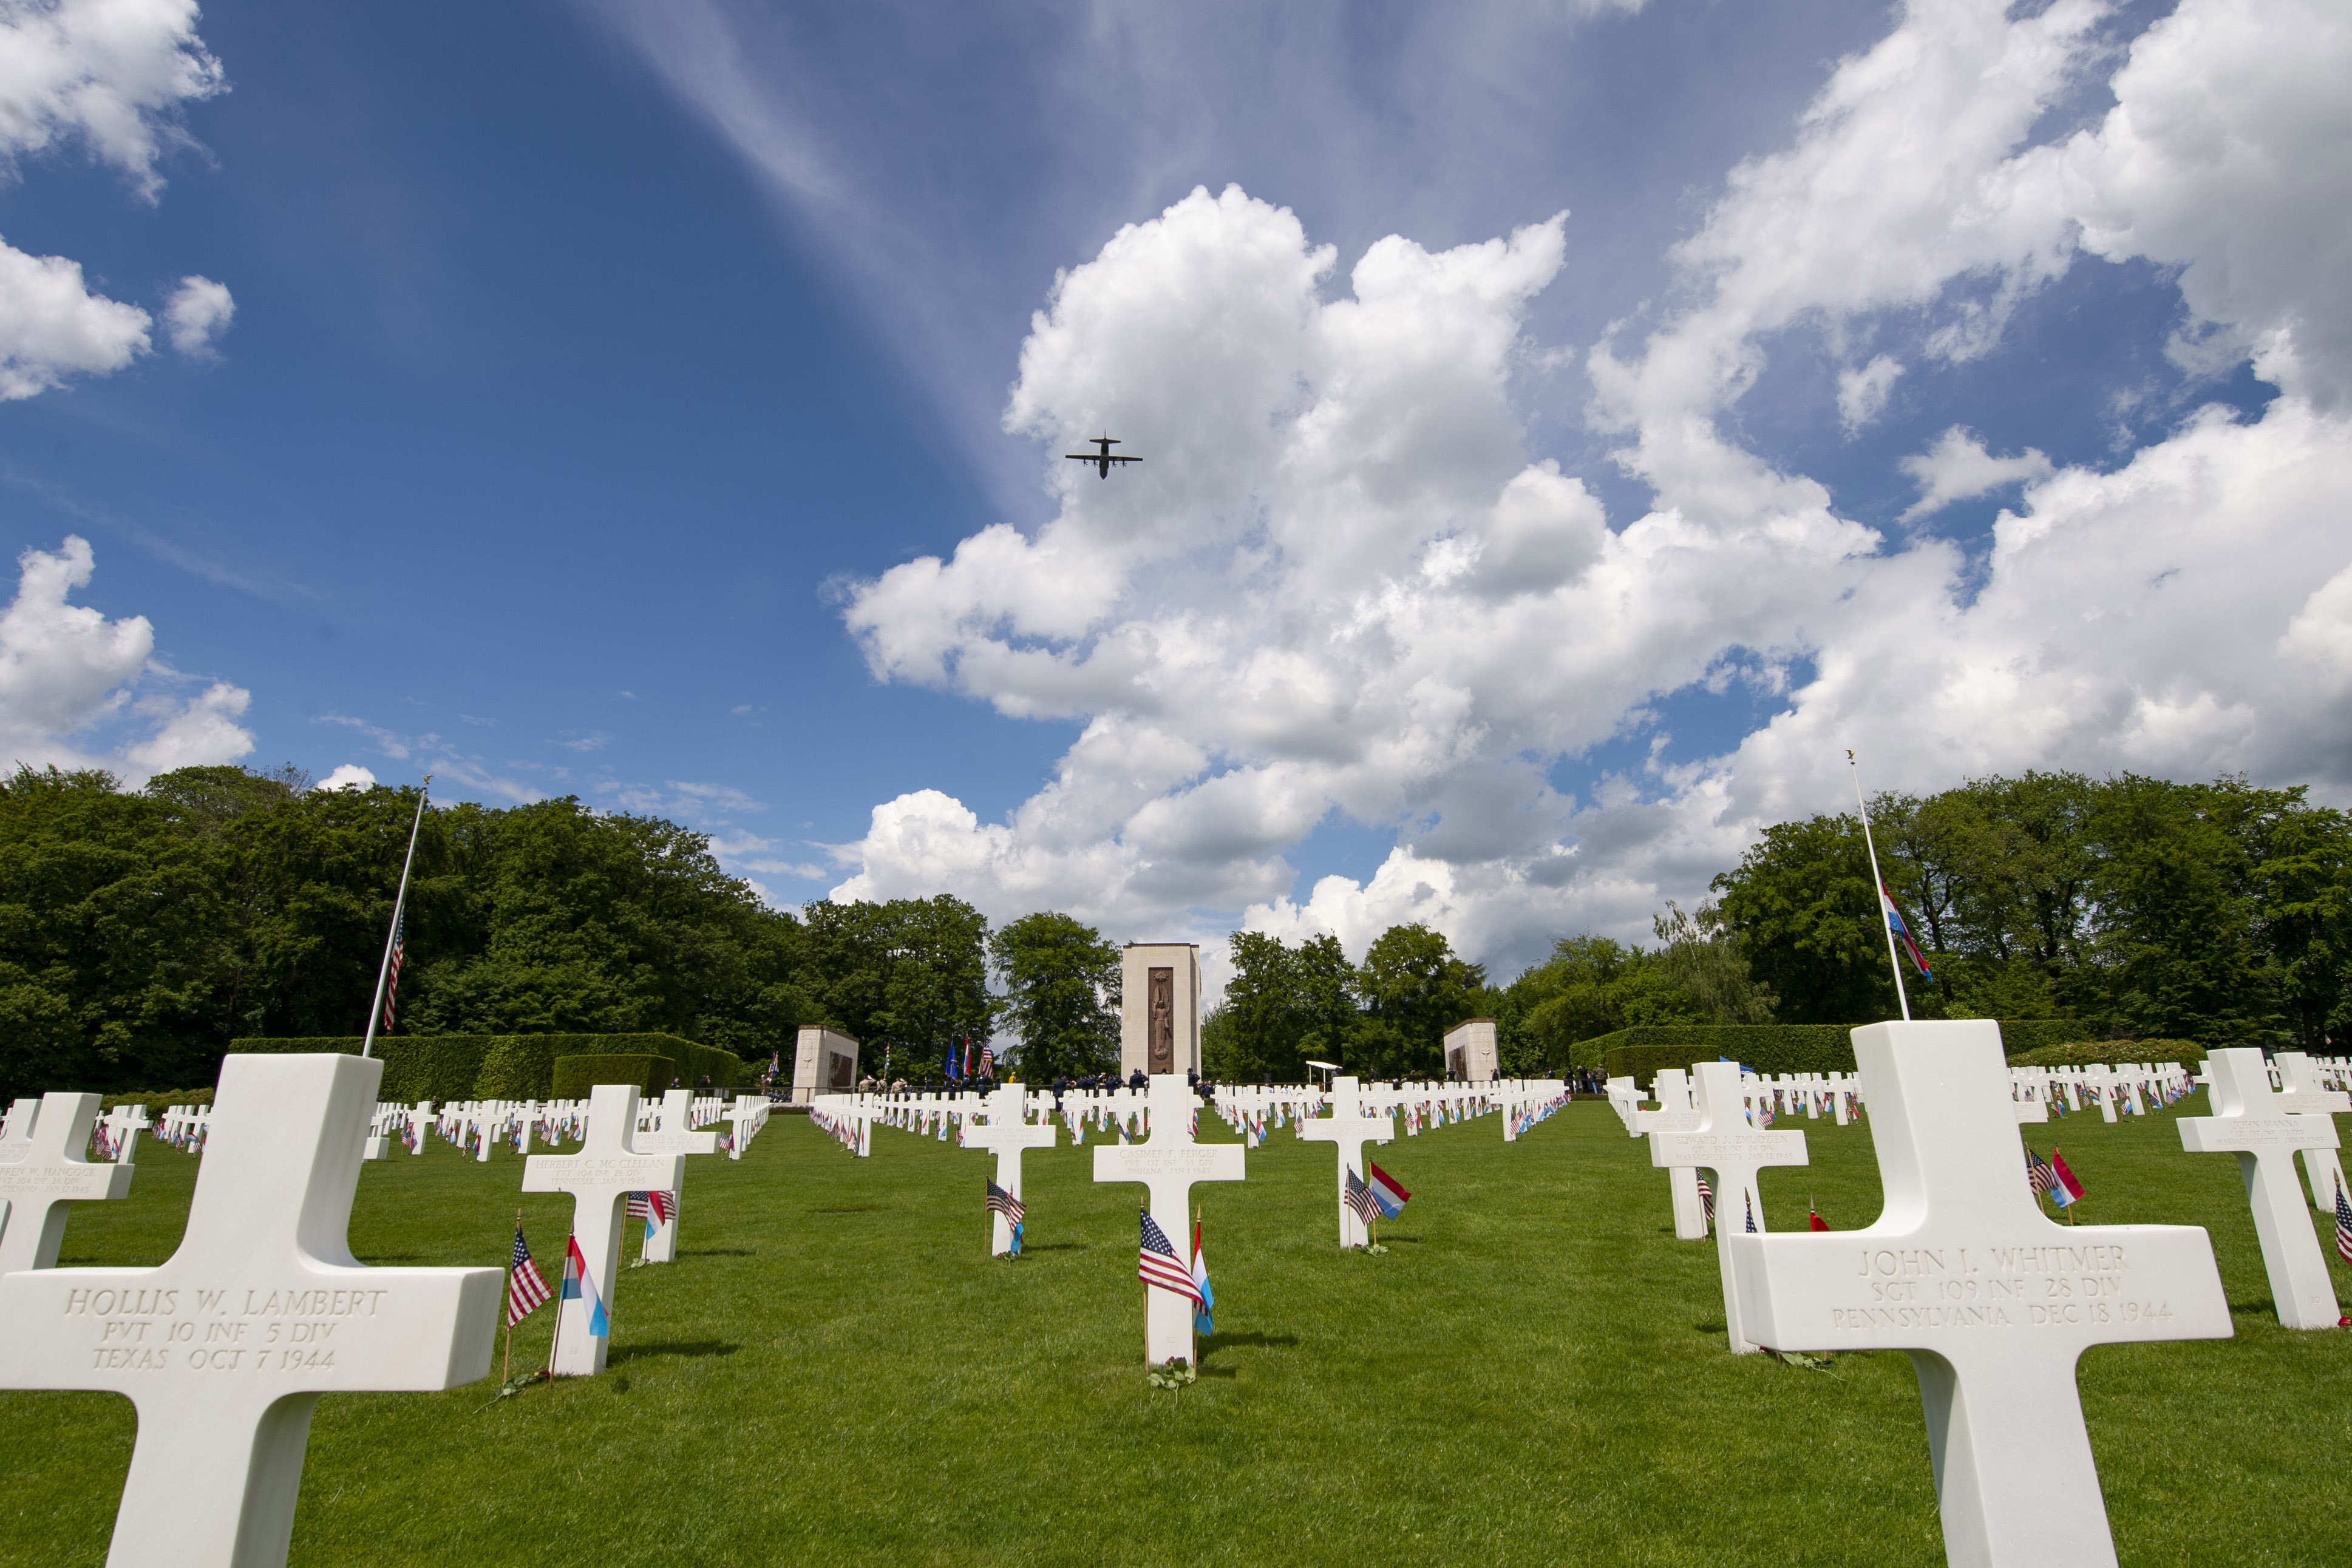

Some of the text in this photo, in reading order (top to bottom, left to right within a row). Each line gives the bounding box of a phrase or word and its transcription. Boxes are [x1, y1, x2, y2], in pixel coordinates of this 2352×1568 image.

[2233, 1121, 2260, 1130] JOHN
[1676, 1135, 1788, 1145] EDWARD J. ZMUDZIEN
[535, 1159, 665, 1169] HERBERT C. MC CLELLAN
[1120, 1149, 1218, 1159] CASIMER F. FERGER
[44, 1167, 97, 1176] HANCOCK
[1858, 1246, 2130, 1277] JOHN I. WHITMER
[1871, 1277, 2123, 1302] SGT 109 INF 28 DIV
[64, 1289, 389, 1317] HOLLIS W. LAMBERT
[1832, 1302, 2174, 1329] PENNSYLVANIA DEC 18 1944
[101, 1322, 338, 1343] PVT 10 INF 5 DIV
[92, 1348, 336, 1370] TEXAS OCT 7 1944
